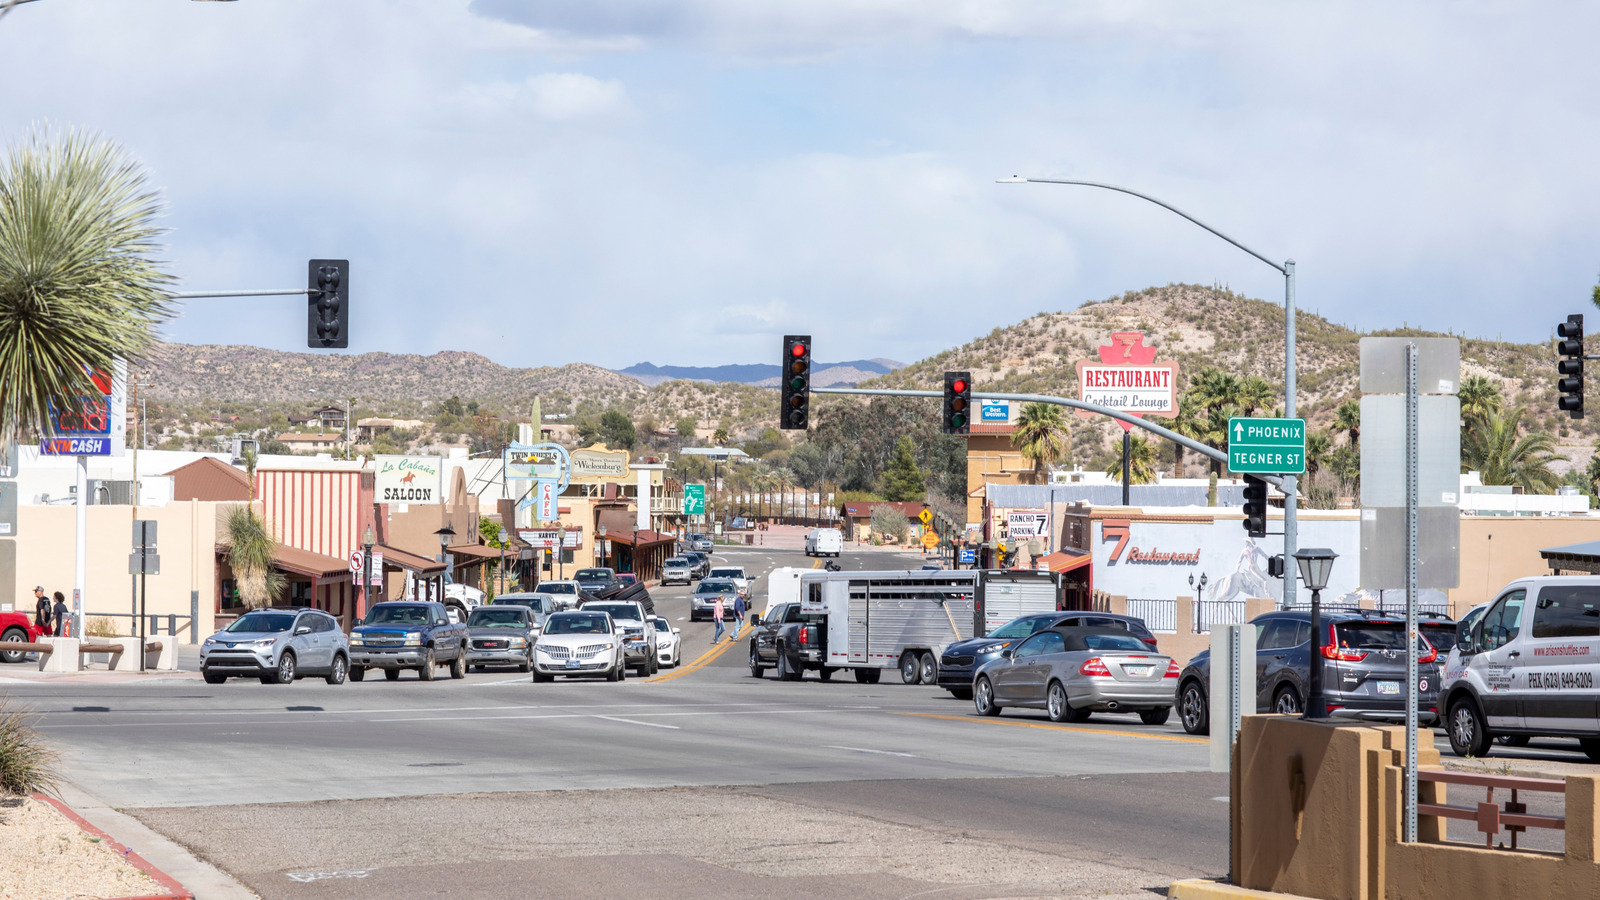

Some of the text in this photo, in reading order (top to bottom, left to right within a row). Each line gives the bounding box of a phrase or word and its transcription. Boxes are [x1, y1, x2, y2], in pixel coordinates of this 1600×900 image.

[1086, 370, 1170, 388] RESTAURANT
[1131, 394, 1169, 410] Lounge
[1248, 426, 1300, 438] PHOENIX
[530, 452, 557, 460] WHEELS
[1234, 453, 1300, 465] TEGNER ST
[381, 461, 394, 473] La
[575, 460, 622, 473] Wickenburg
[384, 487, 431, 501] SALOON
[1010, 514, 1035, 523] RANCHO
[1010, 527, 1035, 536] PARKING
[1036, 518, 1049, 535] 7
[1103, 527, 1131, 561] 7
[1127, 546, 1201, 562] Restaurant
[1528, 672, 1543, 688] PHX
[1543, 672, 1560, 691] (623)
[1561, 672, 1592, 688] 849-6209
